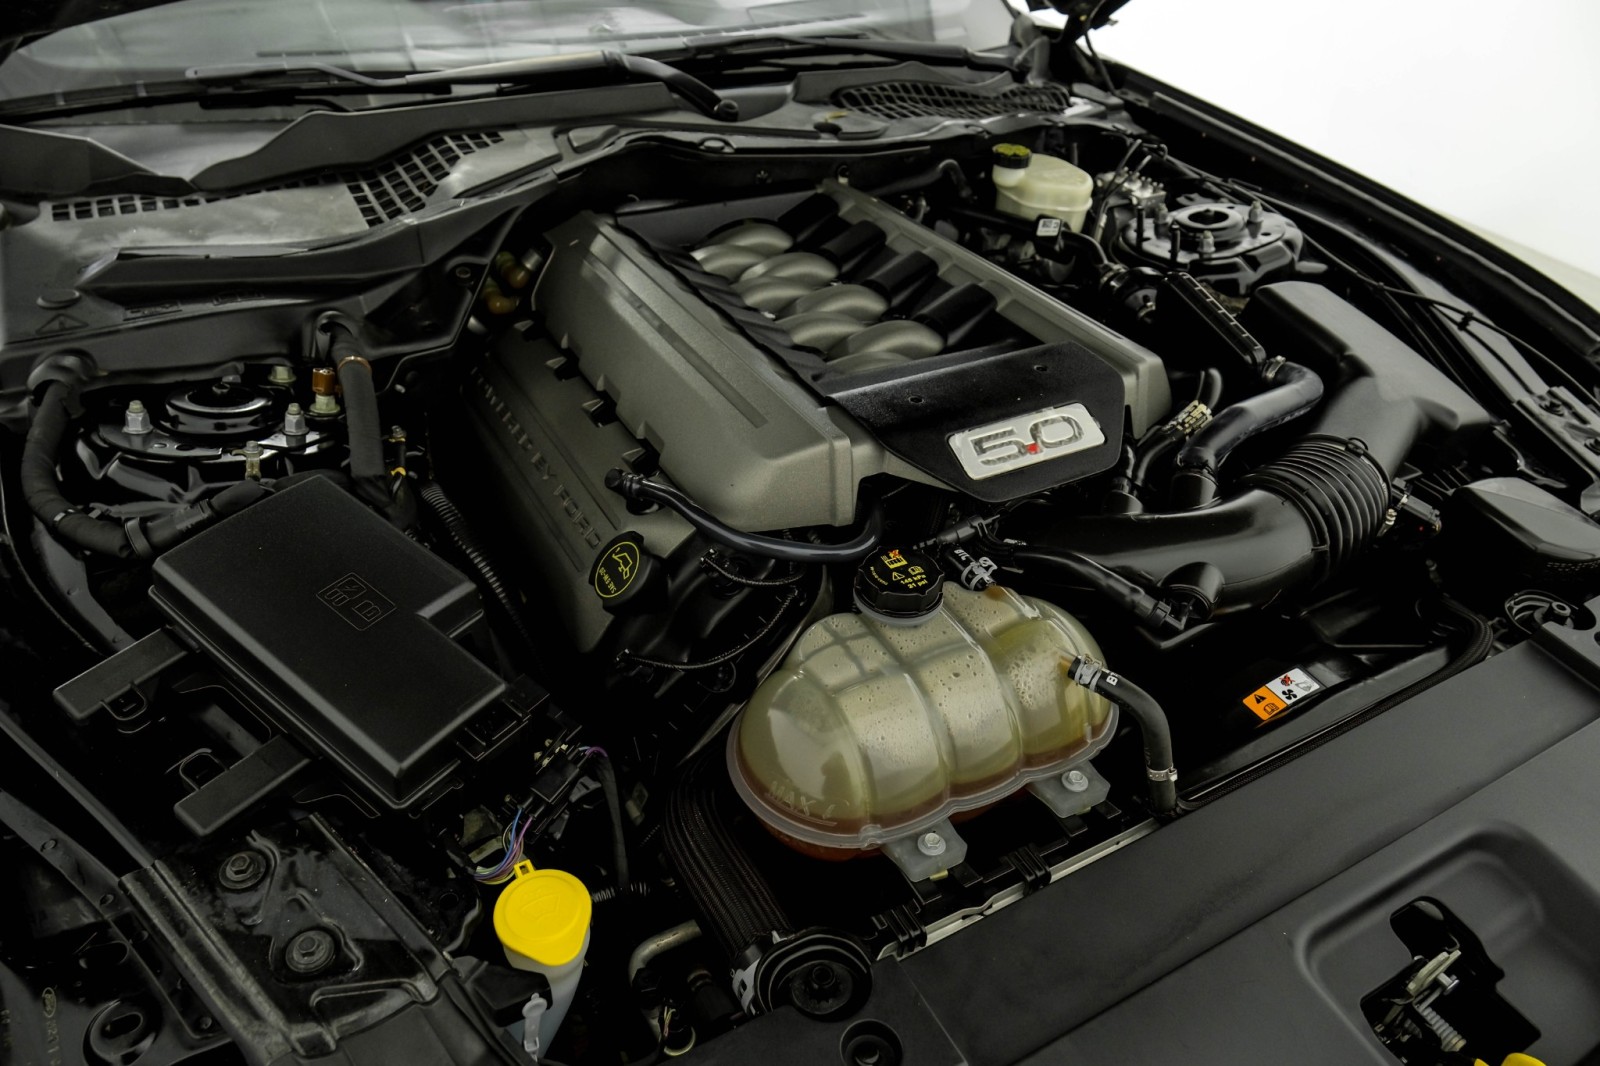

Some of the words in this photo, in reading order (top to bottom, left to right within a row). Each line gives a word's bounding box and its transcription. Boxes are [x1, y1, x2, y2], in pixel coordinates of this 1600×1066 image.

[968, 413, 1085, 466] 5.0
[530, 451, 557, 480] BY
[552, 483, 601, 550] FORD
[607, 581, 617, 594] SAE
[900, 577, 913, 585] 140
[917, 579, 927, 587] psi
[769, 781, 816, 817] MAX
